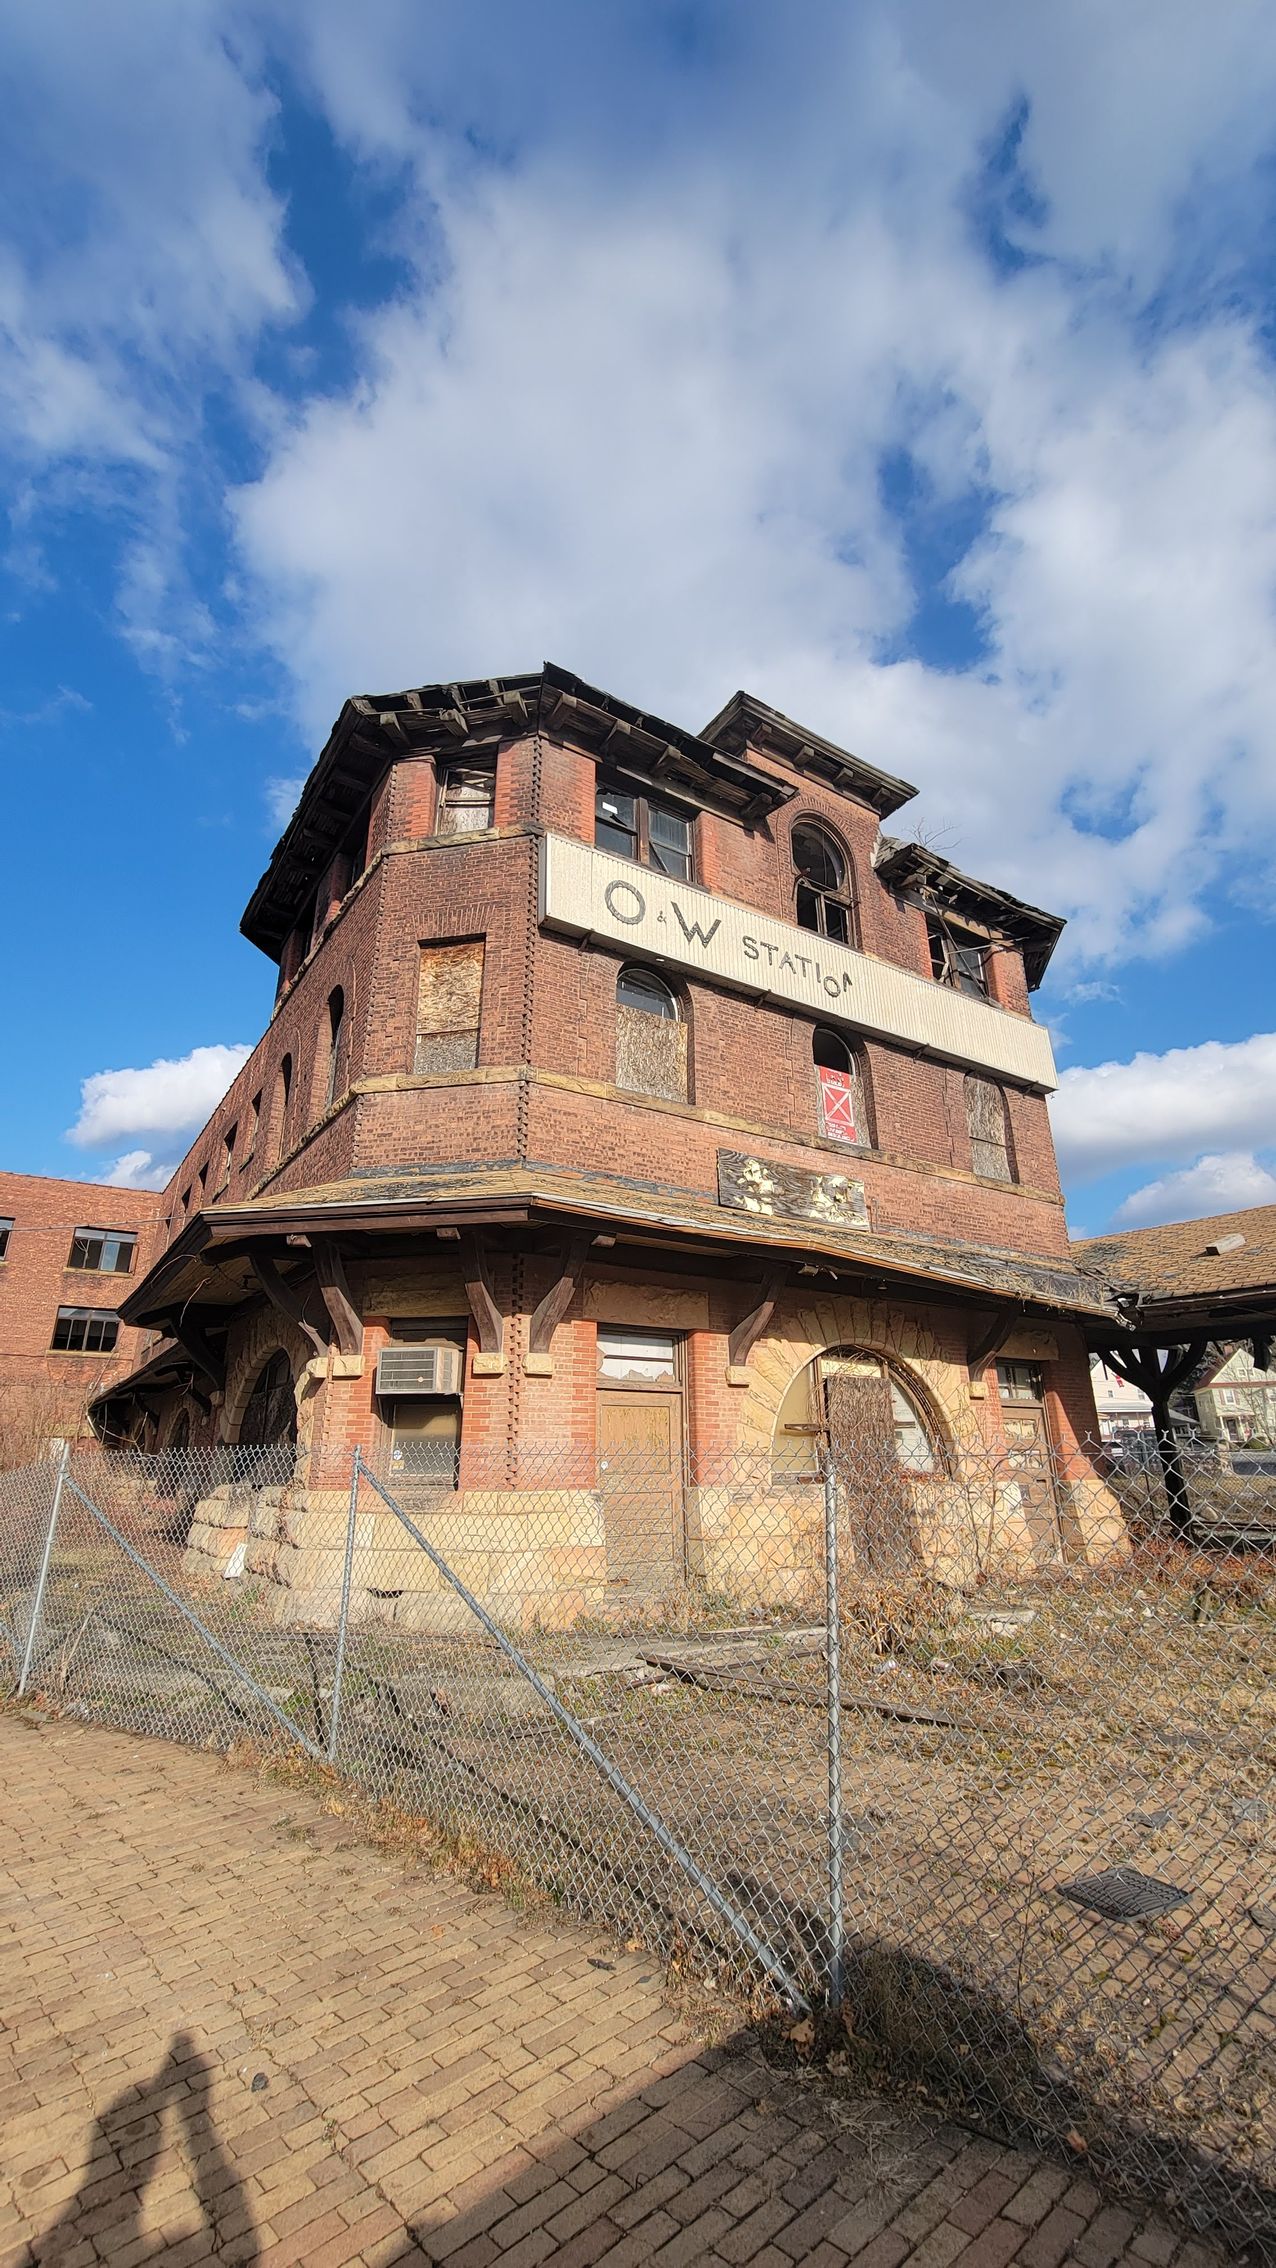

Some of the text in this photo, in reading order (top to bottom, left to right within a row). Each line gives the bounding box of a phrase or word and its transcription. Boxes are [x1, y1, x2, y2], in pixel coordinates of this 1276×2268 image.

[605, 880, 646, 925] O
[657, 911, 667, 925] &
[671, 901, 721, 948] W
